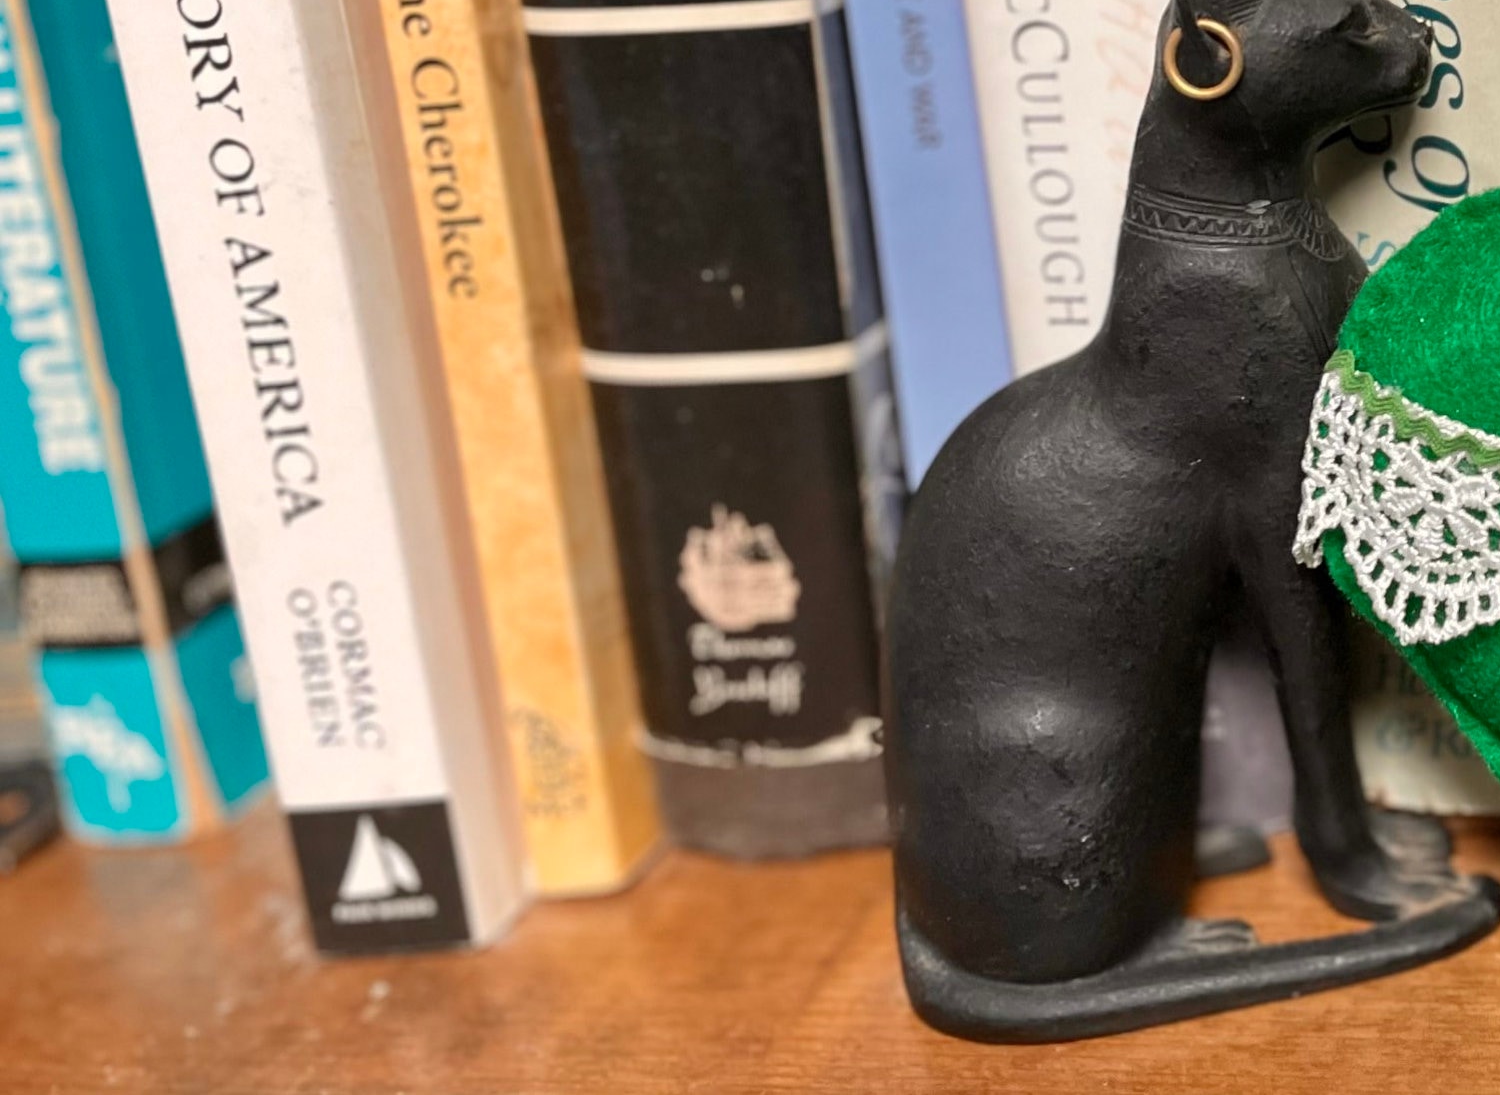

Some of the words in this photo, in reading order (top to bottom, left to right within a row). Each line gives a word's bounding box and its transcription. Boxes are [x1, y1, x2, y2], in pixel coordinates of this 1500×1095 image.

[209, 137, 266, 218] OF
[411, 57, 484, 299] Cherokee
[225, 234, 325, 527] AMERICA
[286, 587, 344, 748] O'BRIEN
[326, 579, 386, 751] CORMAC
